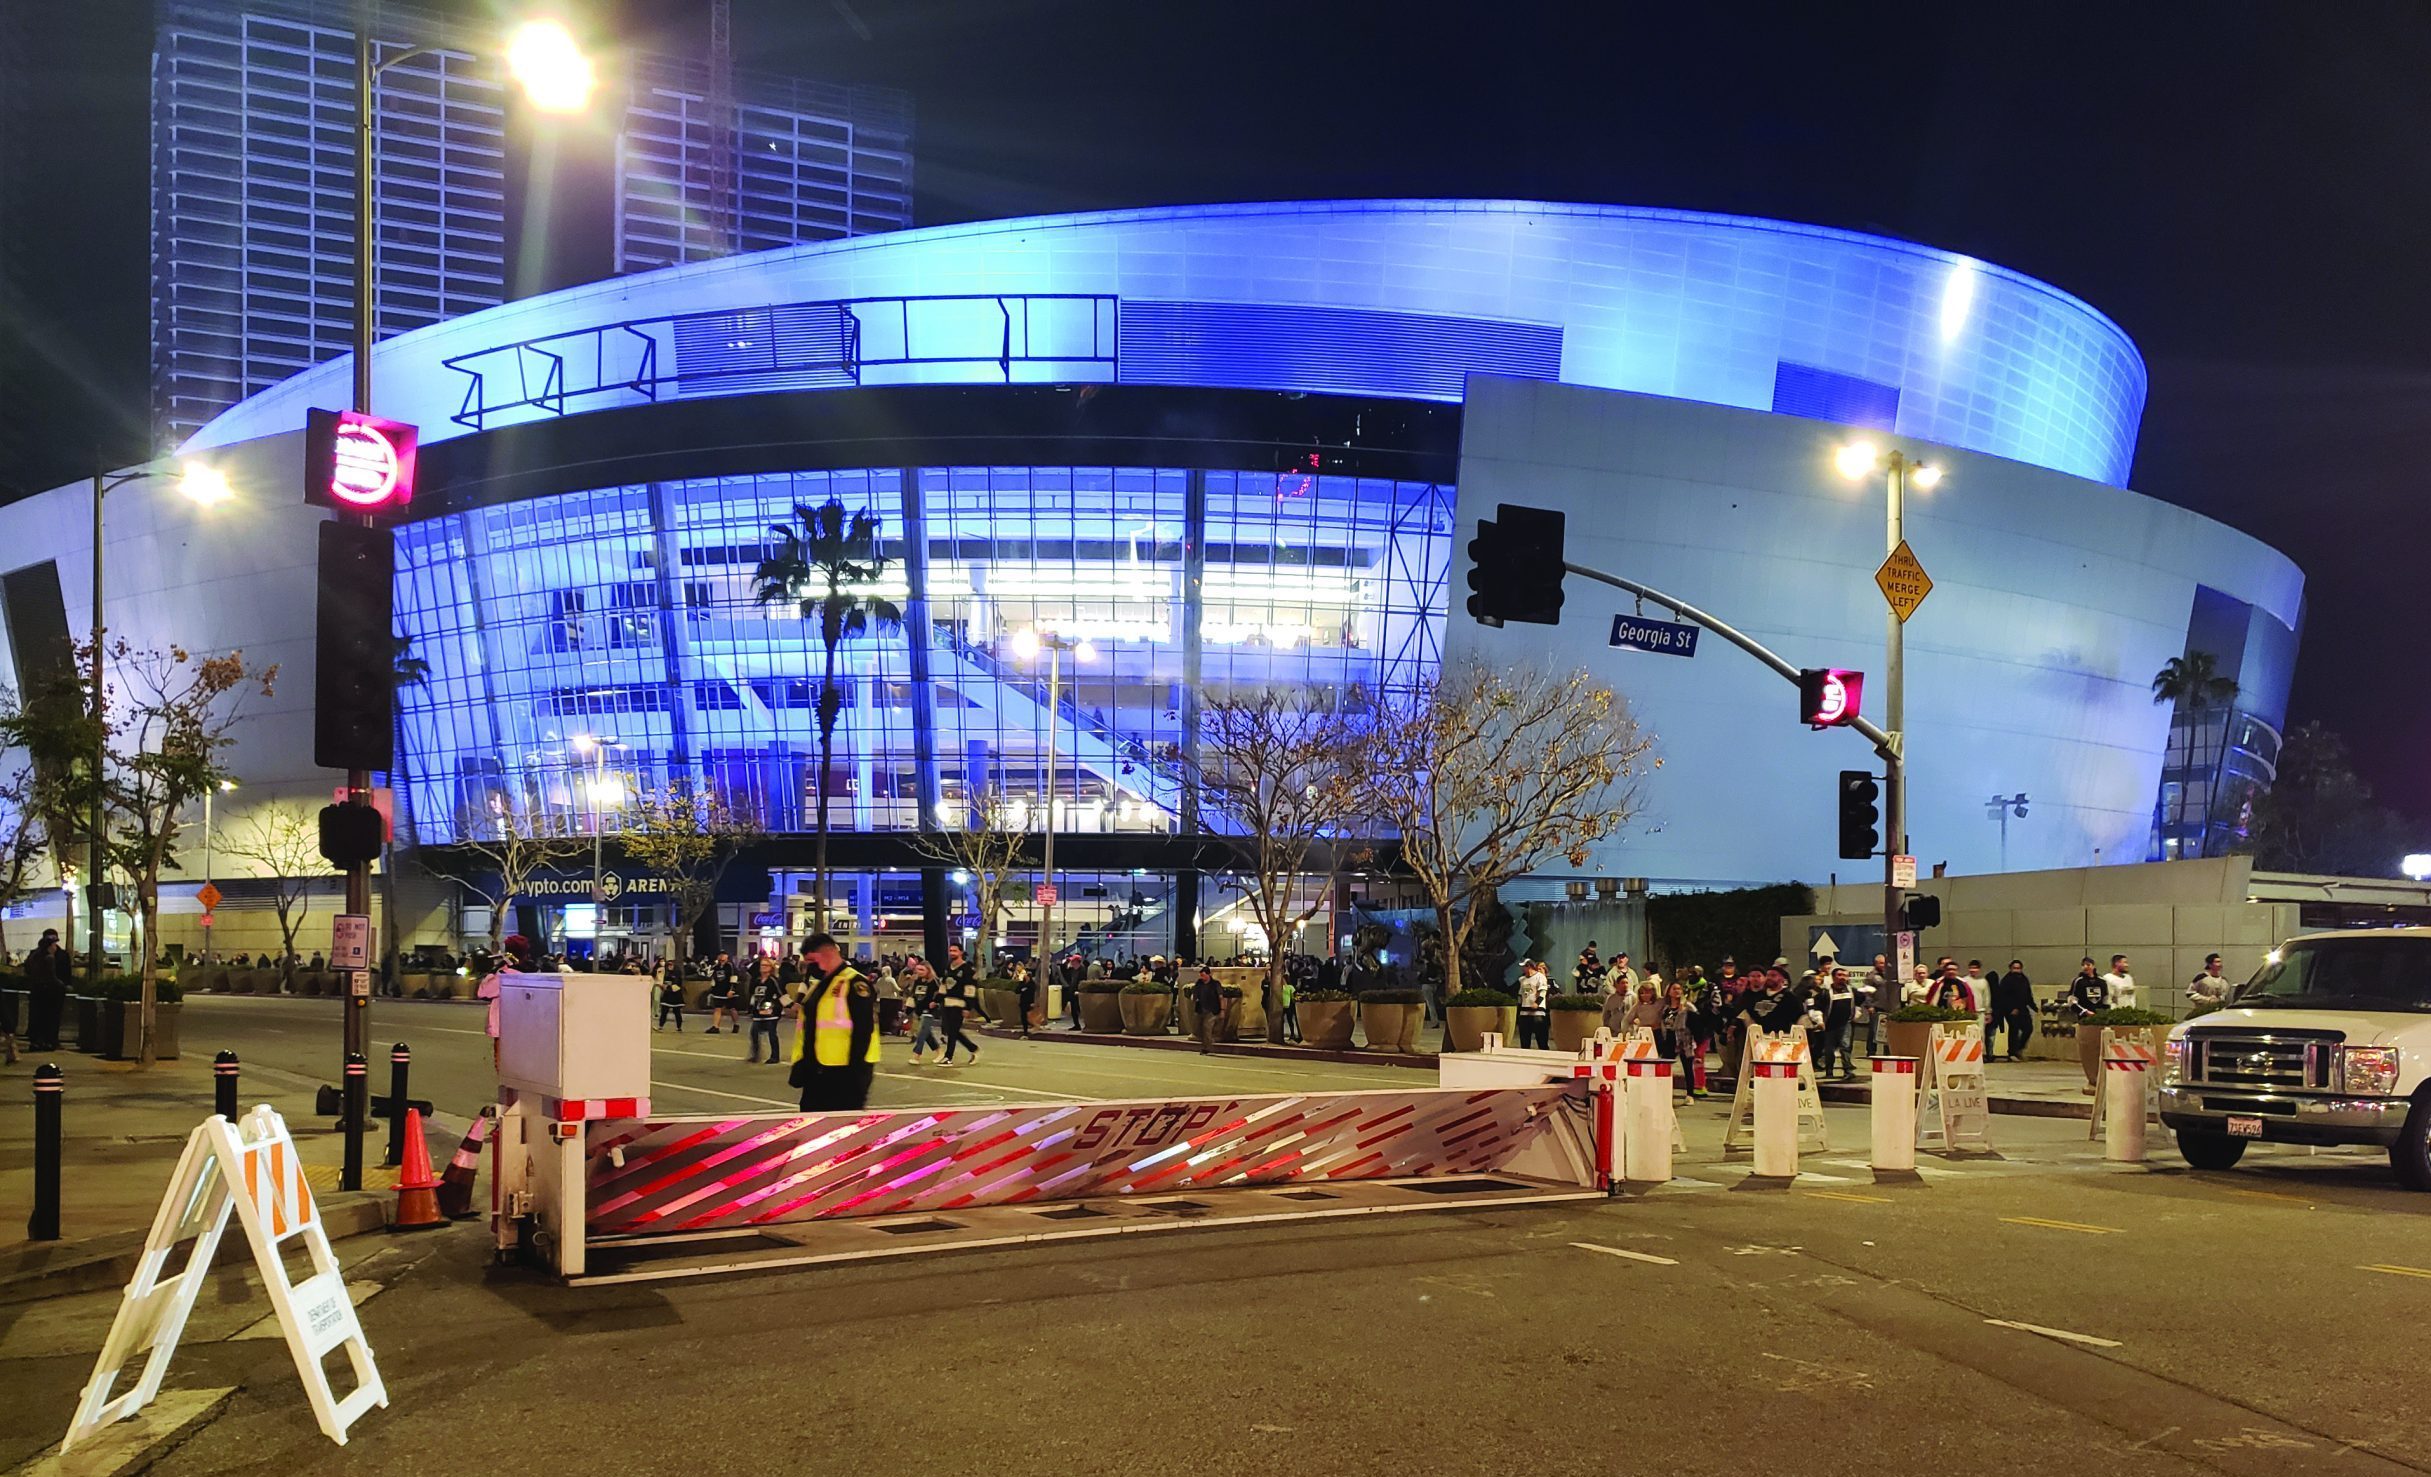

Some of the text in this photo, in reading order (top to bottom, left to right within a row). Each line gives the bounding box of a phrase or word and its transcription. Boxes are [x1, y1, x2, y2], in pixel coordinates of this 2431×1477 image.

[1894, 554, 1914, 567] THRU
[1887, 566, 1921, 582] TRAFFIC
[1887, 581, 1921, 596] MERGE
[1892, 597, 1915, 608] LEFT
[1618, 622, 1692, 649] Georgia St
[1797, 1097, 1814, 1109] IVE
[1963, 1098, 1982, 1108] LIVE
[1072, 1105, 1220, 1150] STOP
